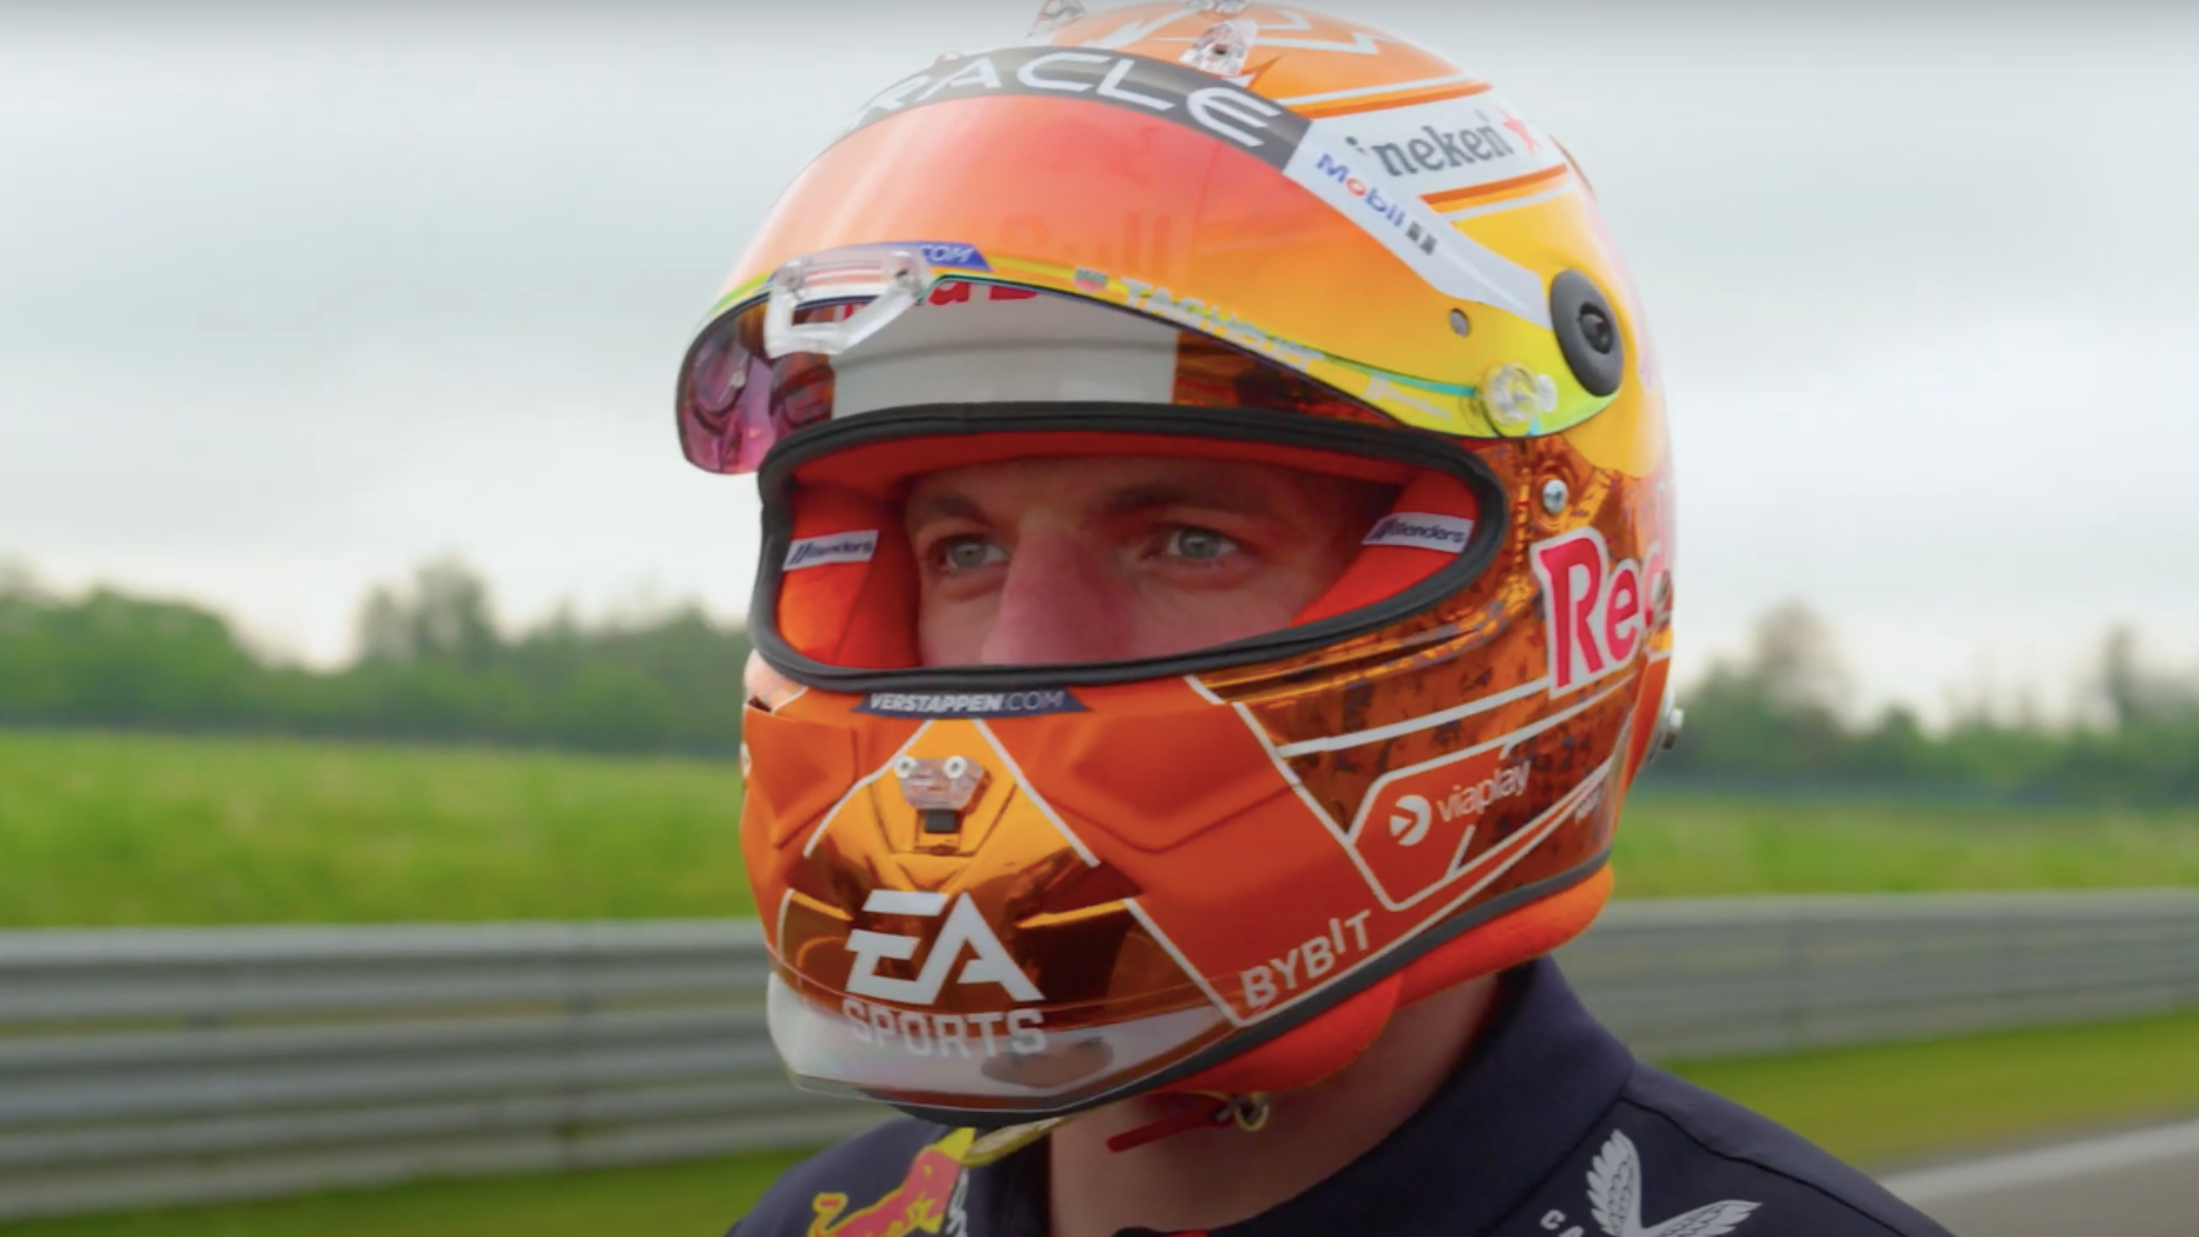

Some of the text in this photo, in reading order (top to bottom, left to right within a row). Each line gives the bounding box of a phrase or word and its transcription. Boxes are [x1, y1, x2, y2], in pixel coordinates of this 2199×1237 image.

[846, 51, 1284, 150] RACLE
[1315, 153, 1406, 227] Mobil
[1437, 760, 1532, 822] viaplay
[845, 889, 1046, 1005] EA
[1240, 908, 1371, 1008] BYBIT
[843, 996, 1047, 1057] SPORTS
